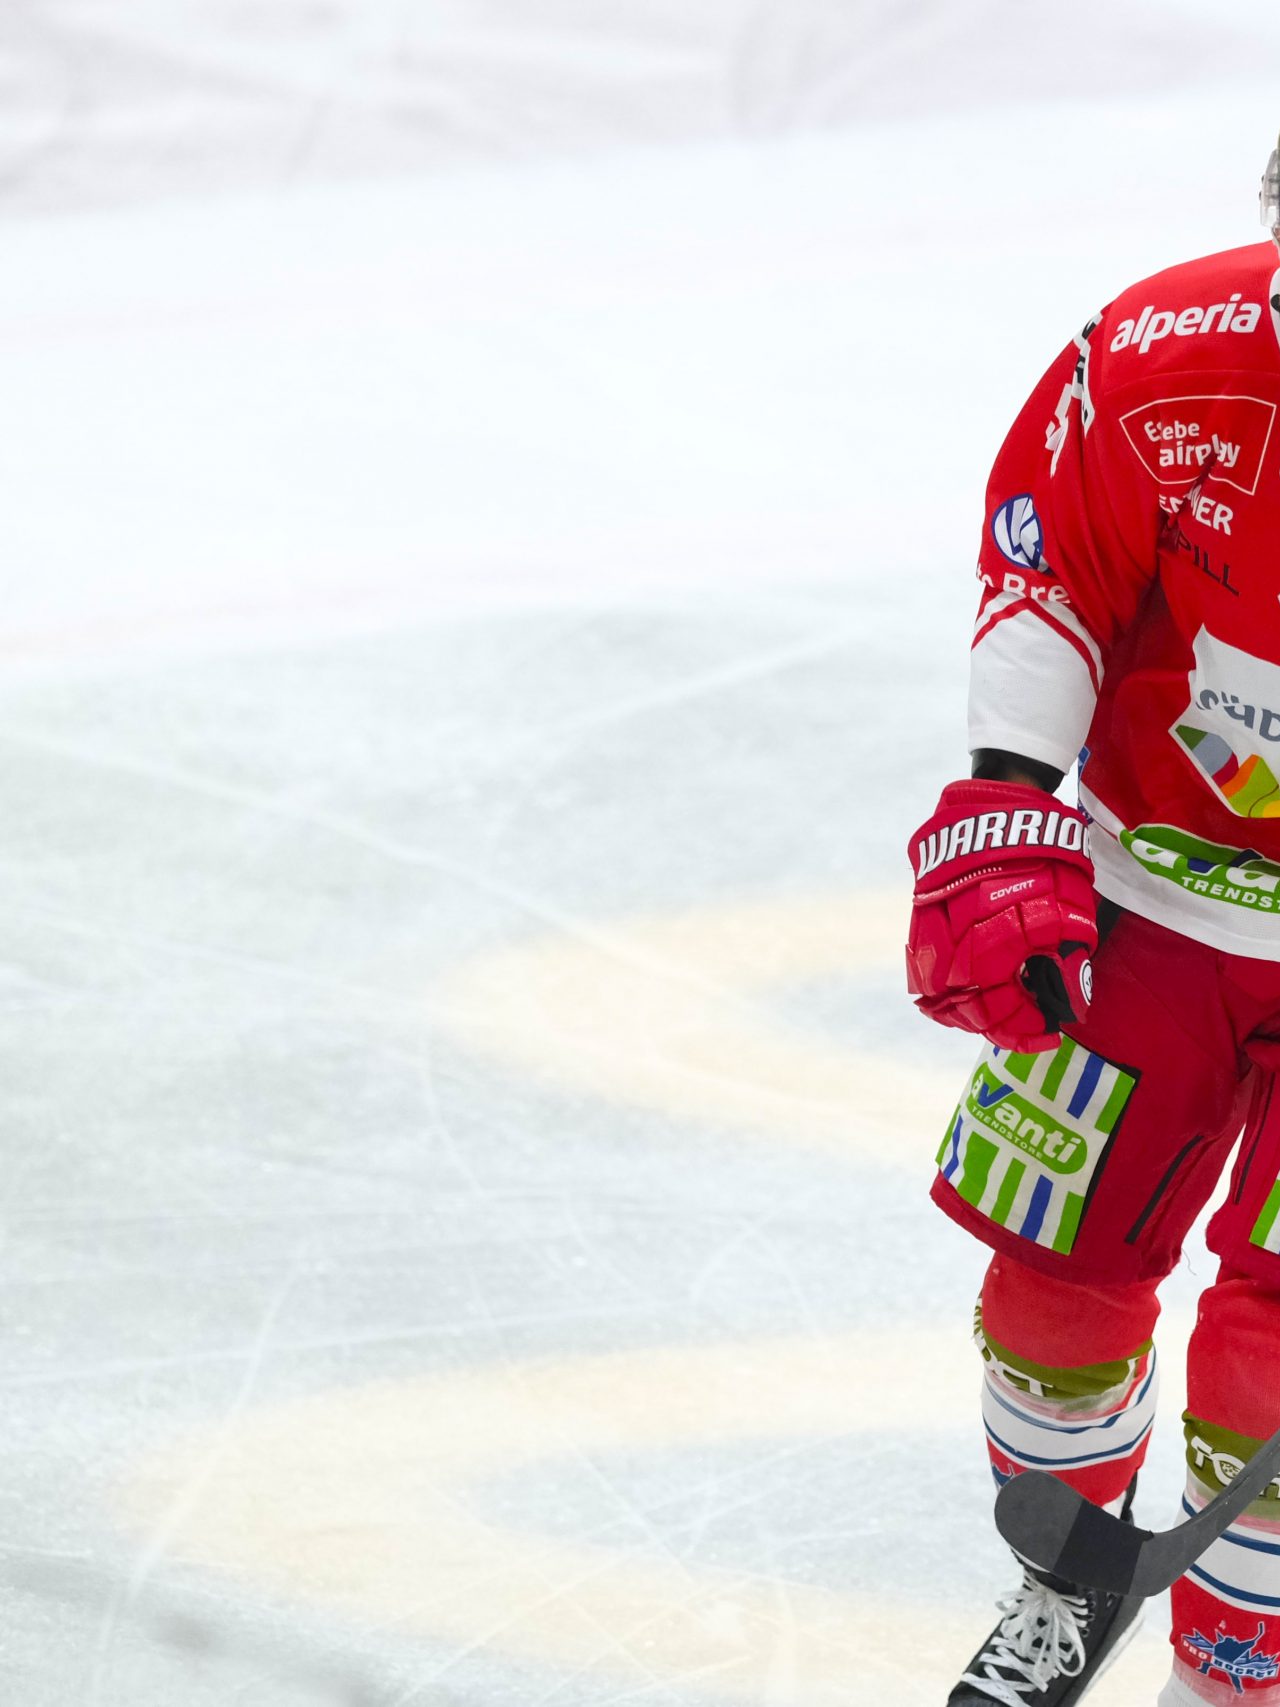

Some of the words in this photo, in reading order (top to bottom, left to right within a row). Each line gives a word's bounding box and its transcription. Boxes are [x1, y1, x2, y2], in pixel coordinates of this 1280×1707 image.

[1110, 293, 1261, 354] alperia
[990, 879, 1036, 901] COVERT
[970, 1073, 1081, 1164] avanti
[971, 1106, 1043, 1159] TRENDSTORE
[1213, 1659, 1275, 1678] HOCKEY
